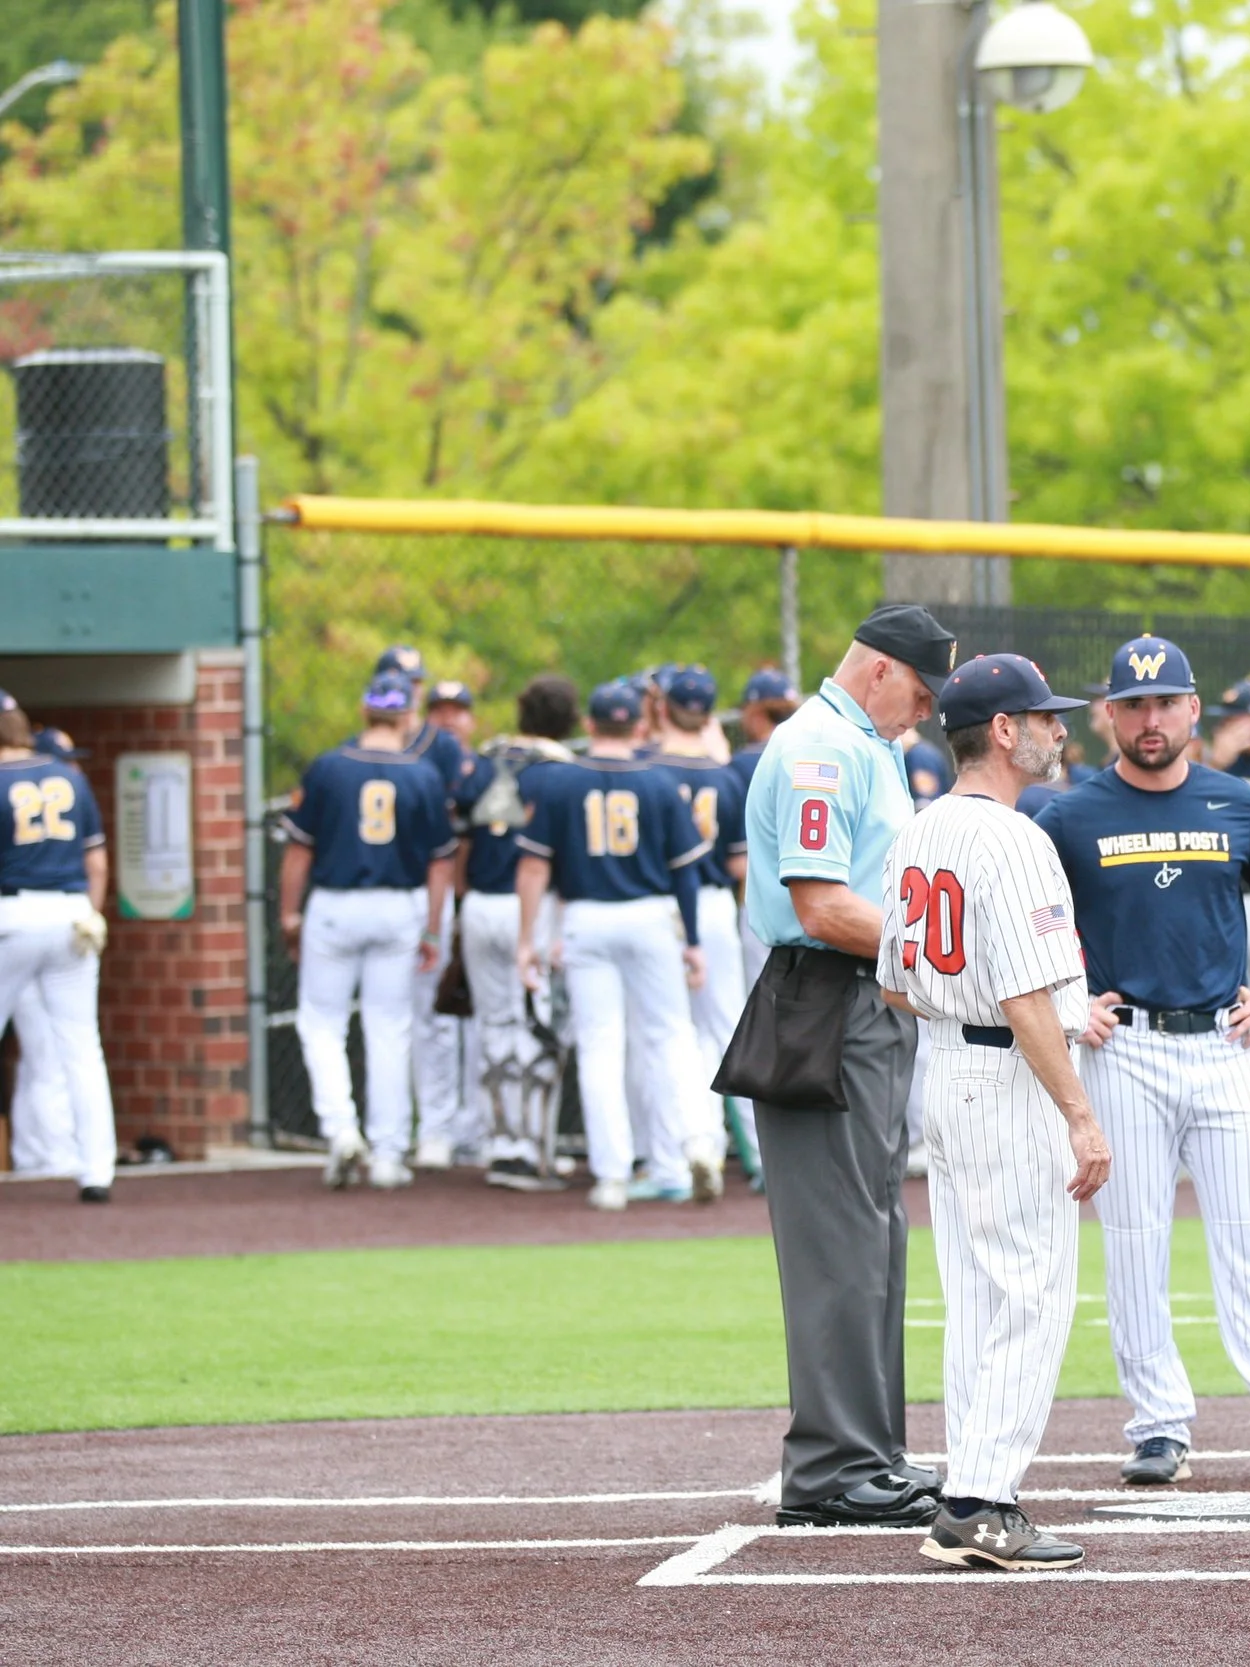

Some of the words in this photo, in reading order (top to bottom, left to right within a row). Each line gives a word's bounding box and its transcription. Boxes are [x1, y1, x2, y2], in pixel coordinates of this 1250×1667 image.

[1128, 651, 1166, 681] W
[8, 776, 76, 846] 22
[359, 779, 396, 844] 9
[799, 798, 829, 851] 8
[1097, 832, 1177, 857] WHEELING
[1179, 831, 1220, 851] POST
[901, 866, 966, 976] 20
